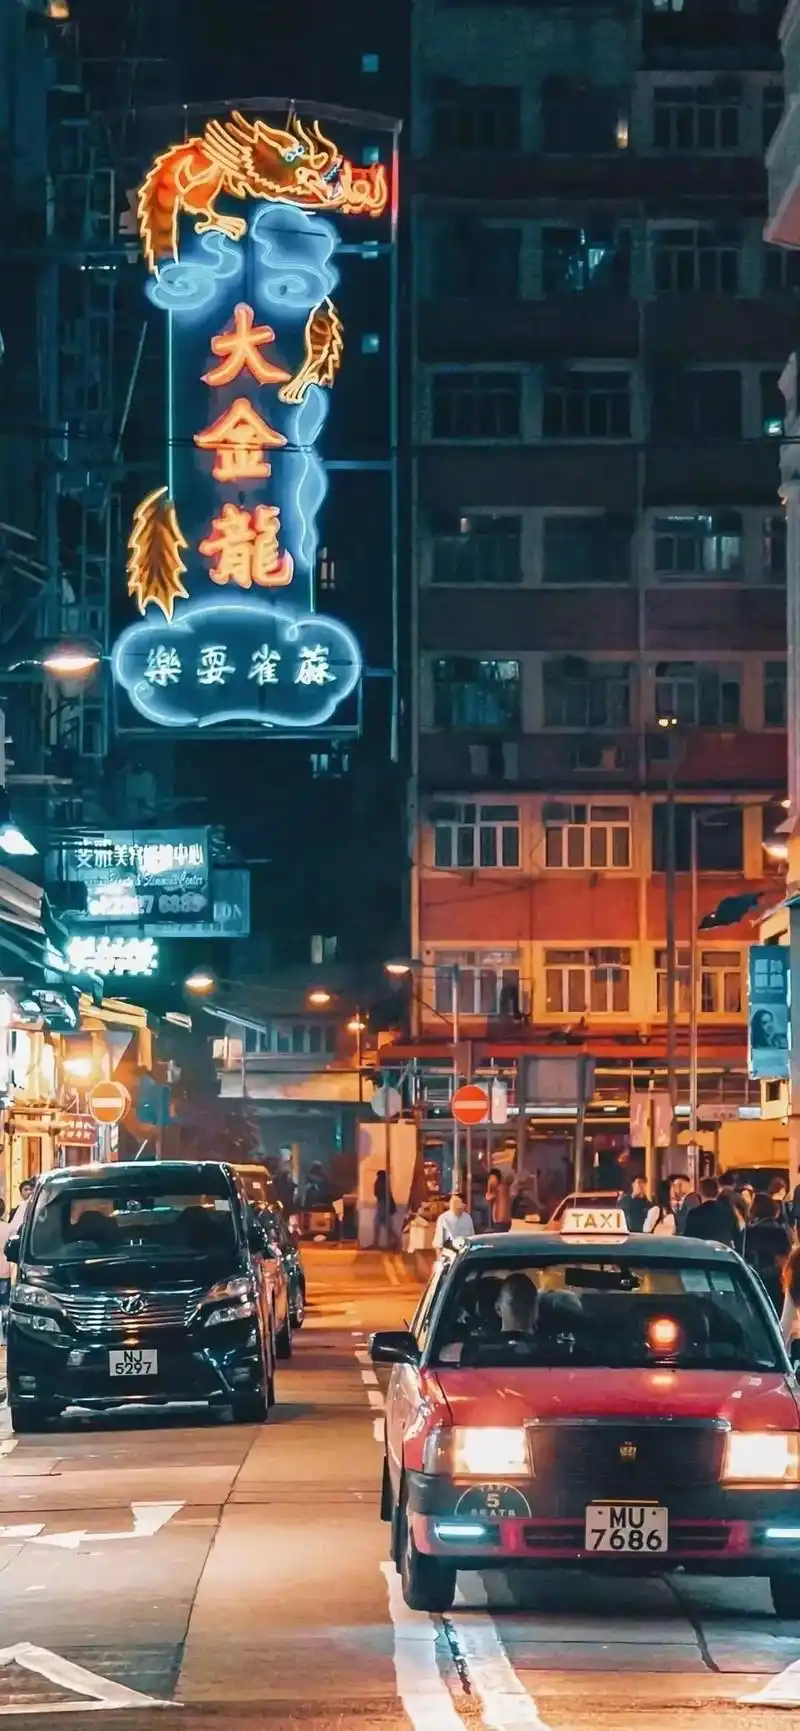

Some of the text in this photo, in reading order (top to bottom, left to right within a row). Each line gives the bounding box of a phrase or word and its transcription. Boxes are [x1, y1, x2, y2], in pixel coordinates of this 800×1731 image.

[193, 301, 294, 589] 大金龍
[571, 1213, 620, 1229] TAXI
[123, 1350, 143, 1362] NJ
[115, 1361, 152, 1375] 5297
[486, 1493, 500, 1508] 5
[609, 1507, 645, 1528] MU
[591, 1529, 663, 1550] 7686
